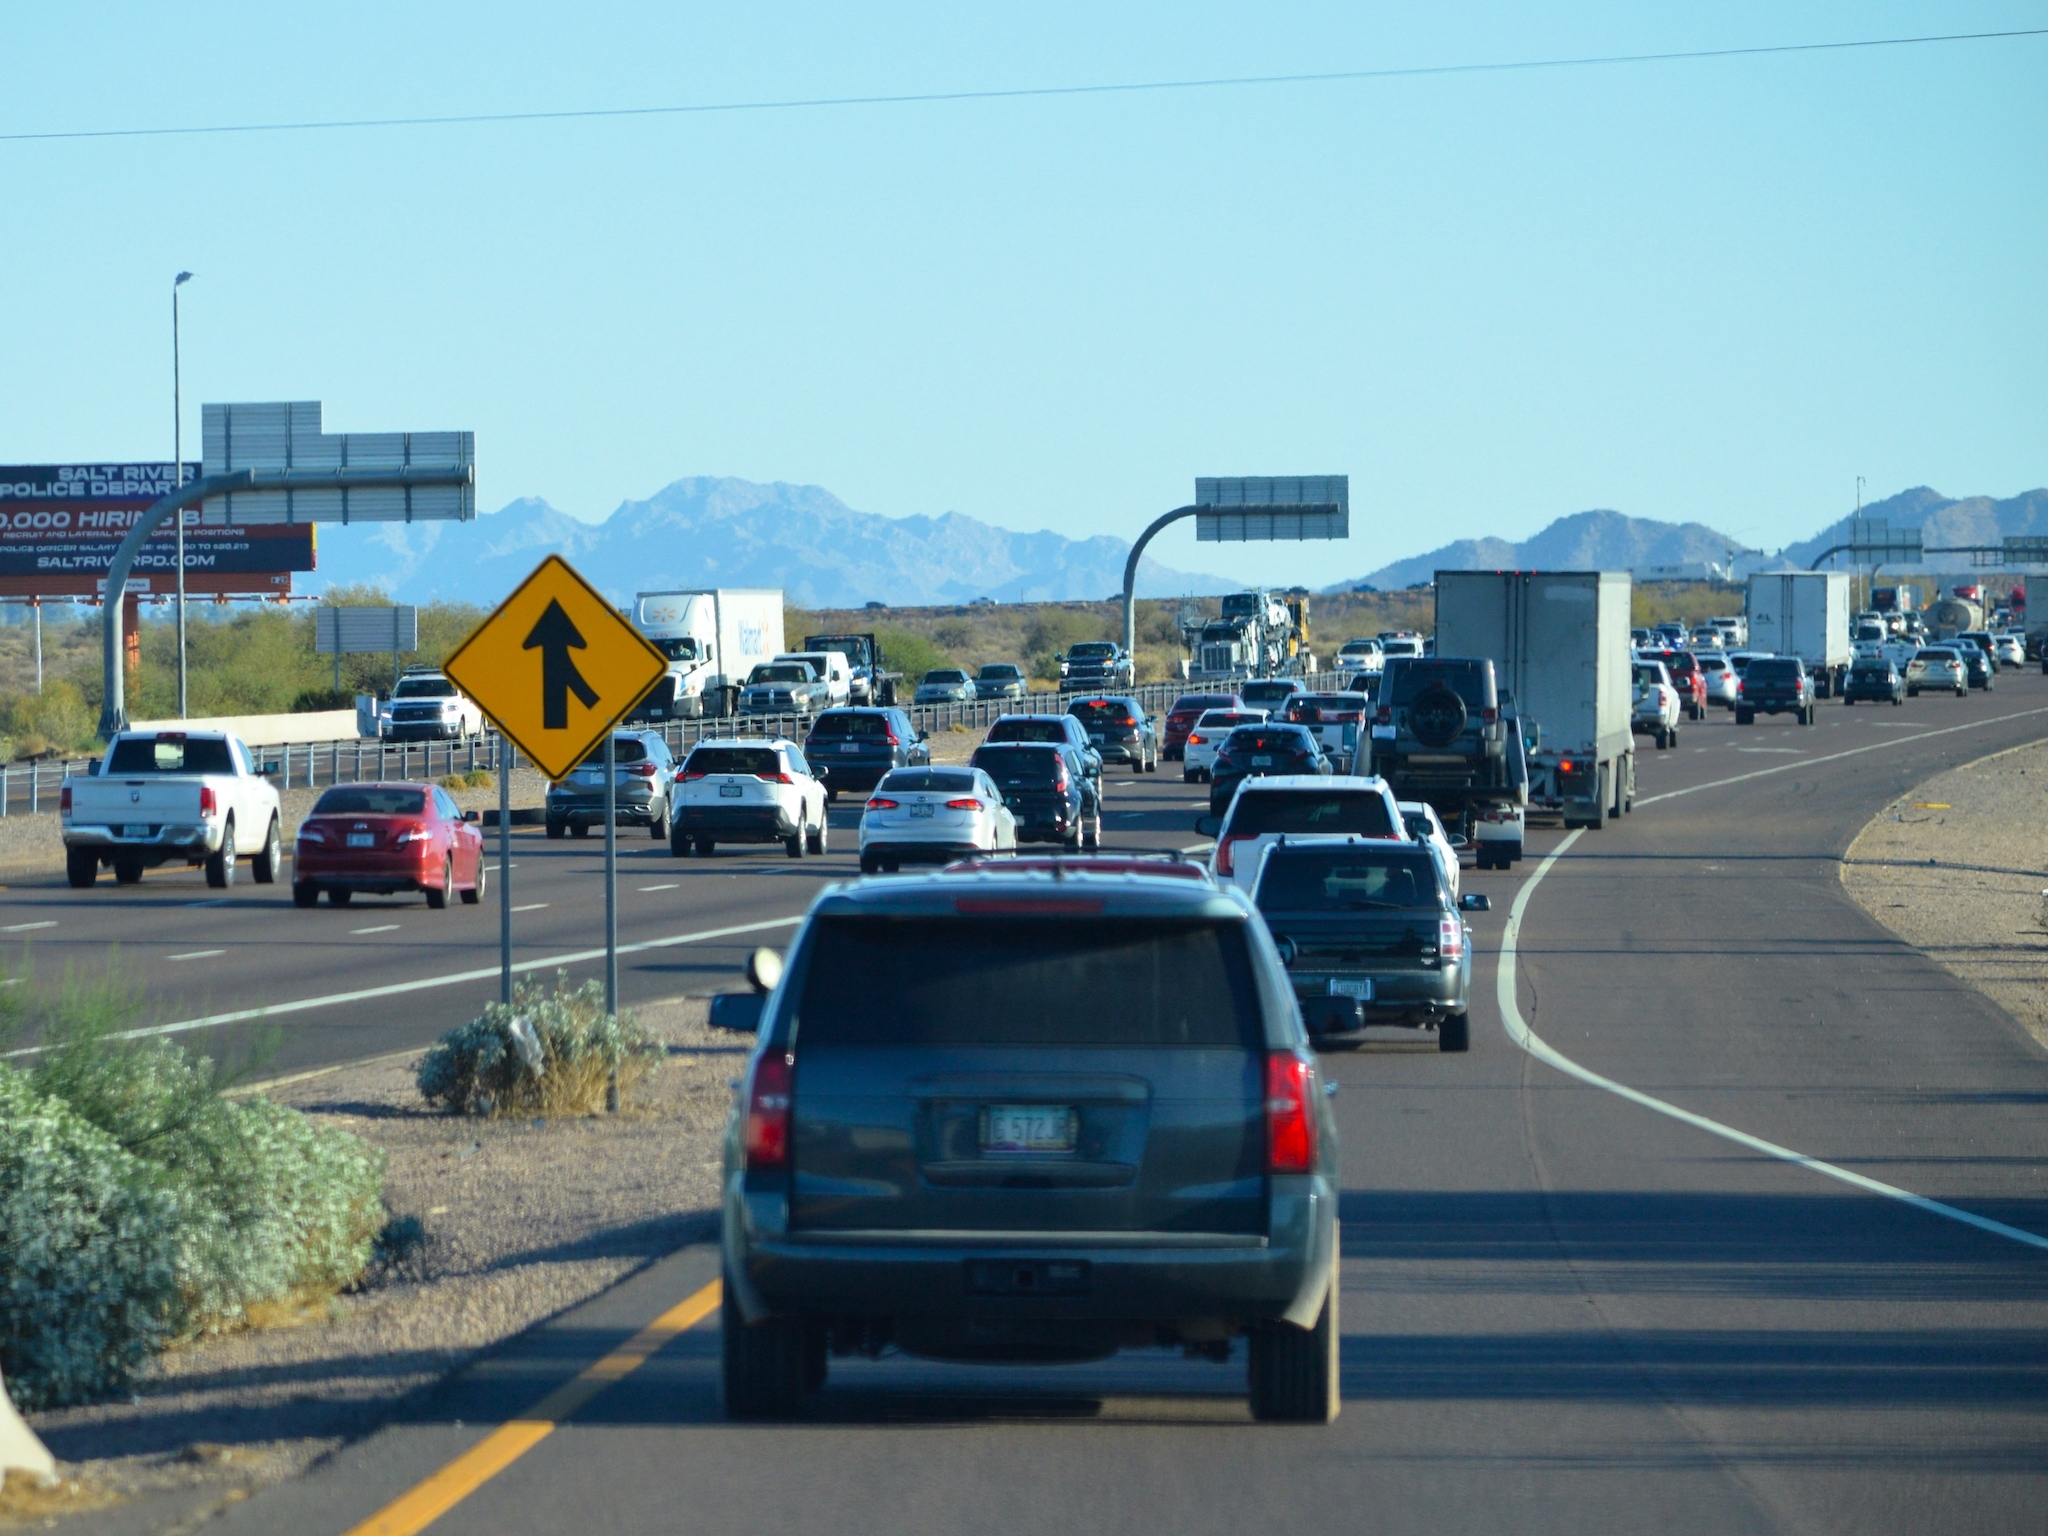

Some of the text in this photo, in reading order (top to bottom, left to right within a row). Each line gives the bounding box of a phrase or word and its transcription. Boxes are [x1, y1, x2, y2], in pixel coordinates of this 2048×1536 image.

[58, 465, 195, 482] SALT RIVER
[0, 480, 192, 498] POLICE DEPAR
[3, 530, 44, 539] RECRUIT
[45, 530, 67, 538] AND
[68, 530, 112, 538] LATERAL
[193, 528, 246, 536] POSITIONS
[0, 545, 34, 553] POLICE
[36, 544, 77, 552] OFFICER
[79, 543, 117, 552] SALARY
[37, 554, 216, 568] SALTRIVRPD.COM
[737, 619, 763, 656] Walmart
